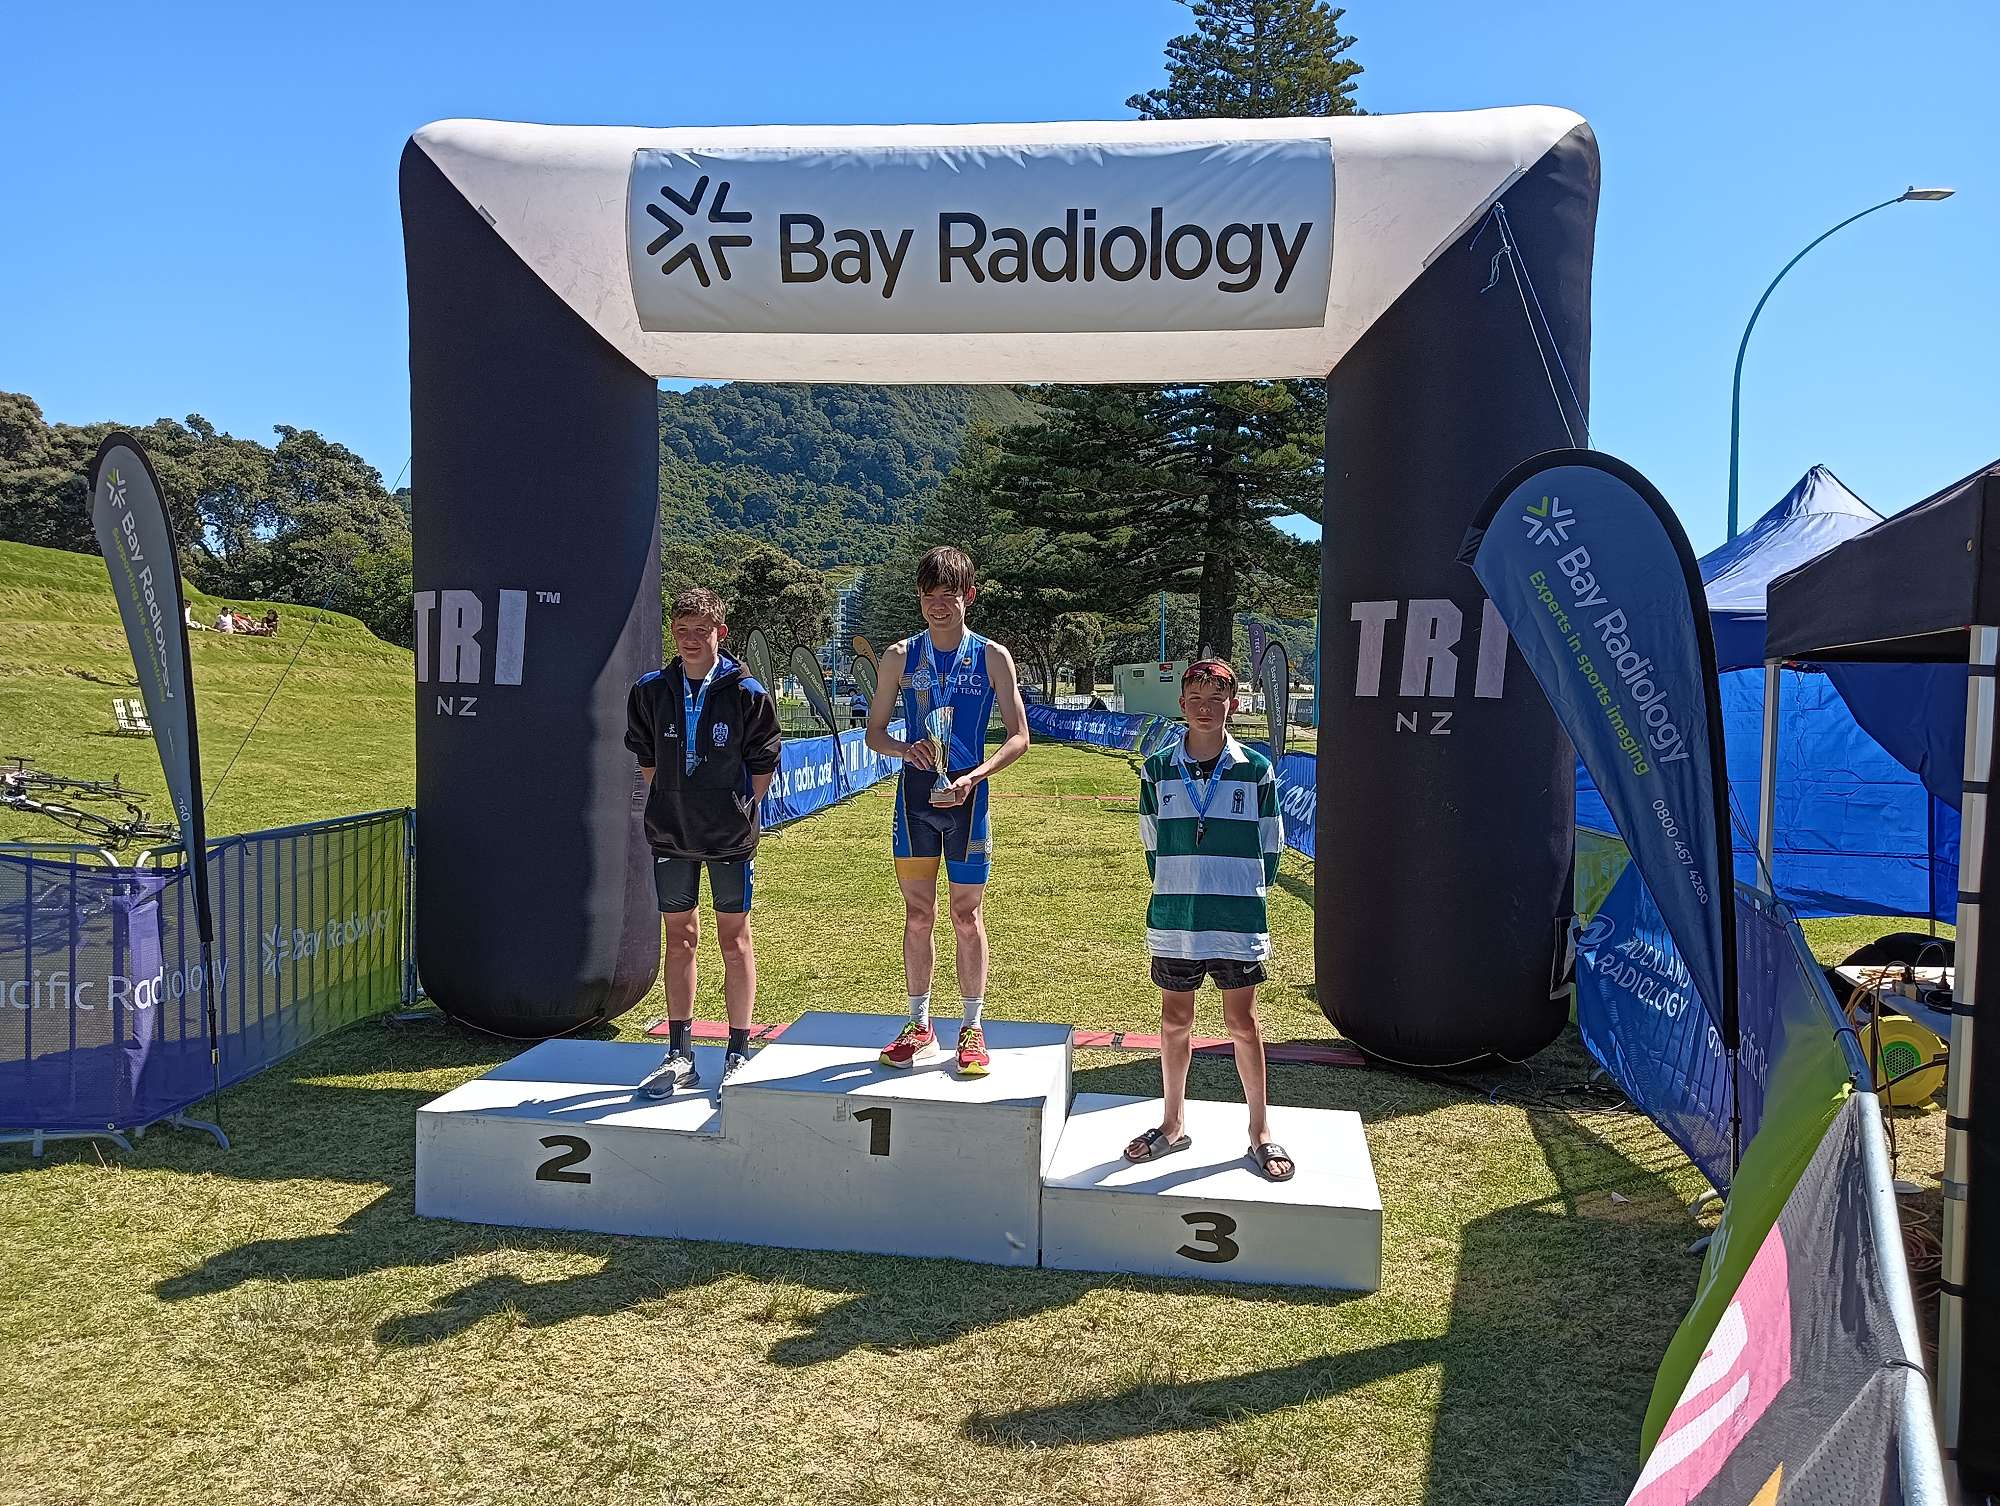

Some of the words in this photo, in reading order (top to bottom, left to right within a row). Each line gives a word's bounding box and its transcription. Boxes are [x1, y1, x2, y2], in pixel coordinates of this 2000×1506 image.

[779, 213, 914, 299] Bay
[939, 207, 1313, 294] Radiology
[122, 510, 144, 561] Bay
[414, 589, 528, 686] TRI
[536, 591, 561, 604] TM
[1351, 599, 1509, 699] TRI
[1557, 545, 1608, 608] Bay
[1593, 608, 1690, 763] Radiology
[960, 687, 982, 695] TEAM
[1529, 570, 1573, 634] Experts
[1566, 632, 1583, 653] in
[1577, 653, 1612, 706] sports
[1606, 704, 1650, 776] imaging
[436, 695, 478, 716] NZ
[1396, 711, 1453, 735] NZ
[1652, 799, 1679, 838] 0800
[1674, 840, 1694, 865] 467
[1689, 869, 1709, 905] 4260
[1597, 953, 1689, 1022] RADIOLOGY
[1614, 936, 1691, 989] AUCKLAND
[852, 1106, 892, 1157] 1
[535, 1134, 592, 1184] 2
[1175, 1211, 1239, 1263] 3
